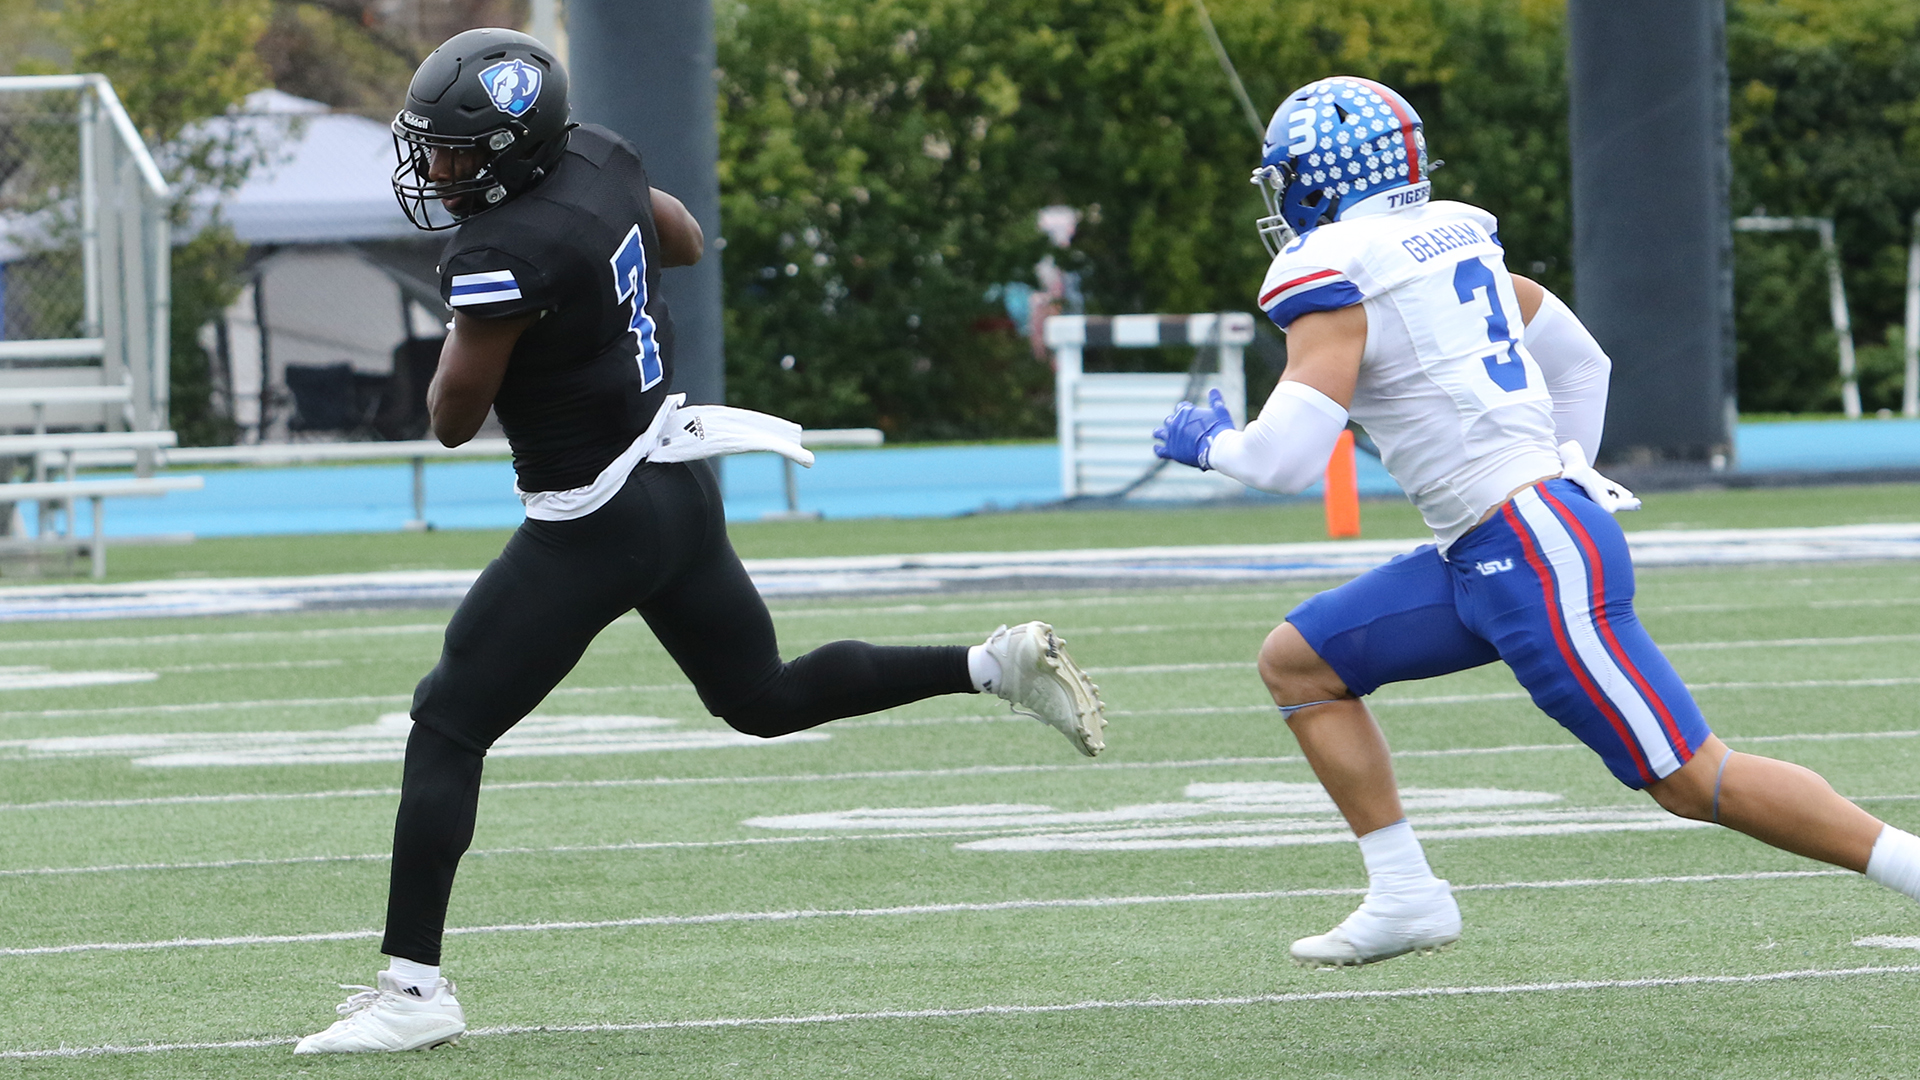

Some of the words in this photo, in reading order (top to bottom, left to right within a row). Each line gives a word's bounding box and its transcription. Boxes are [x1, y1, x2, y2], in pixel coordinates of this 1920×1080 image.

[404, 112, 429, 130] Riddell
[1288, 108, 1316, 156] 3
[1401, 222, 1485, 263] GRAHAM
[1453, 256, 1527, 393] 3
